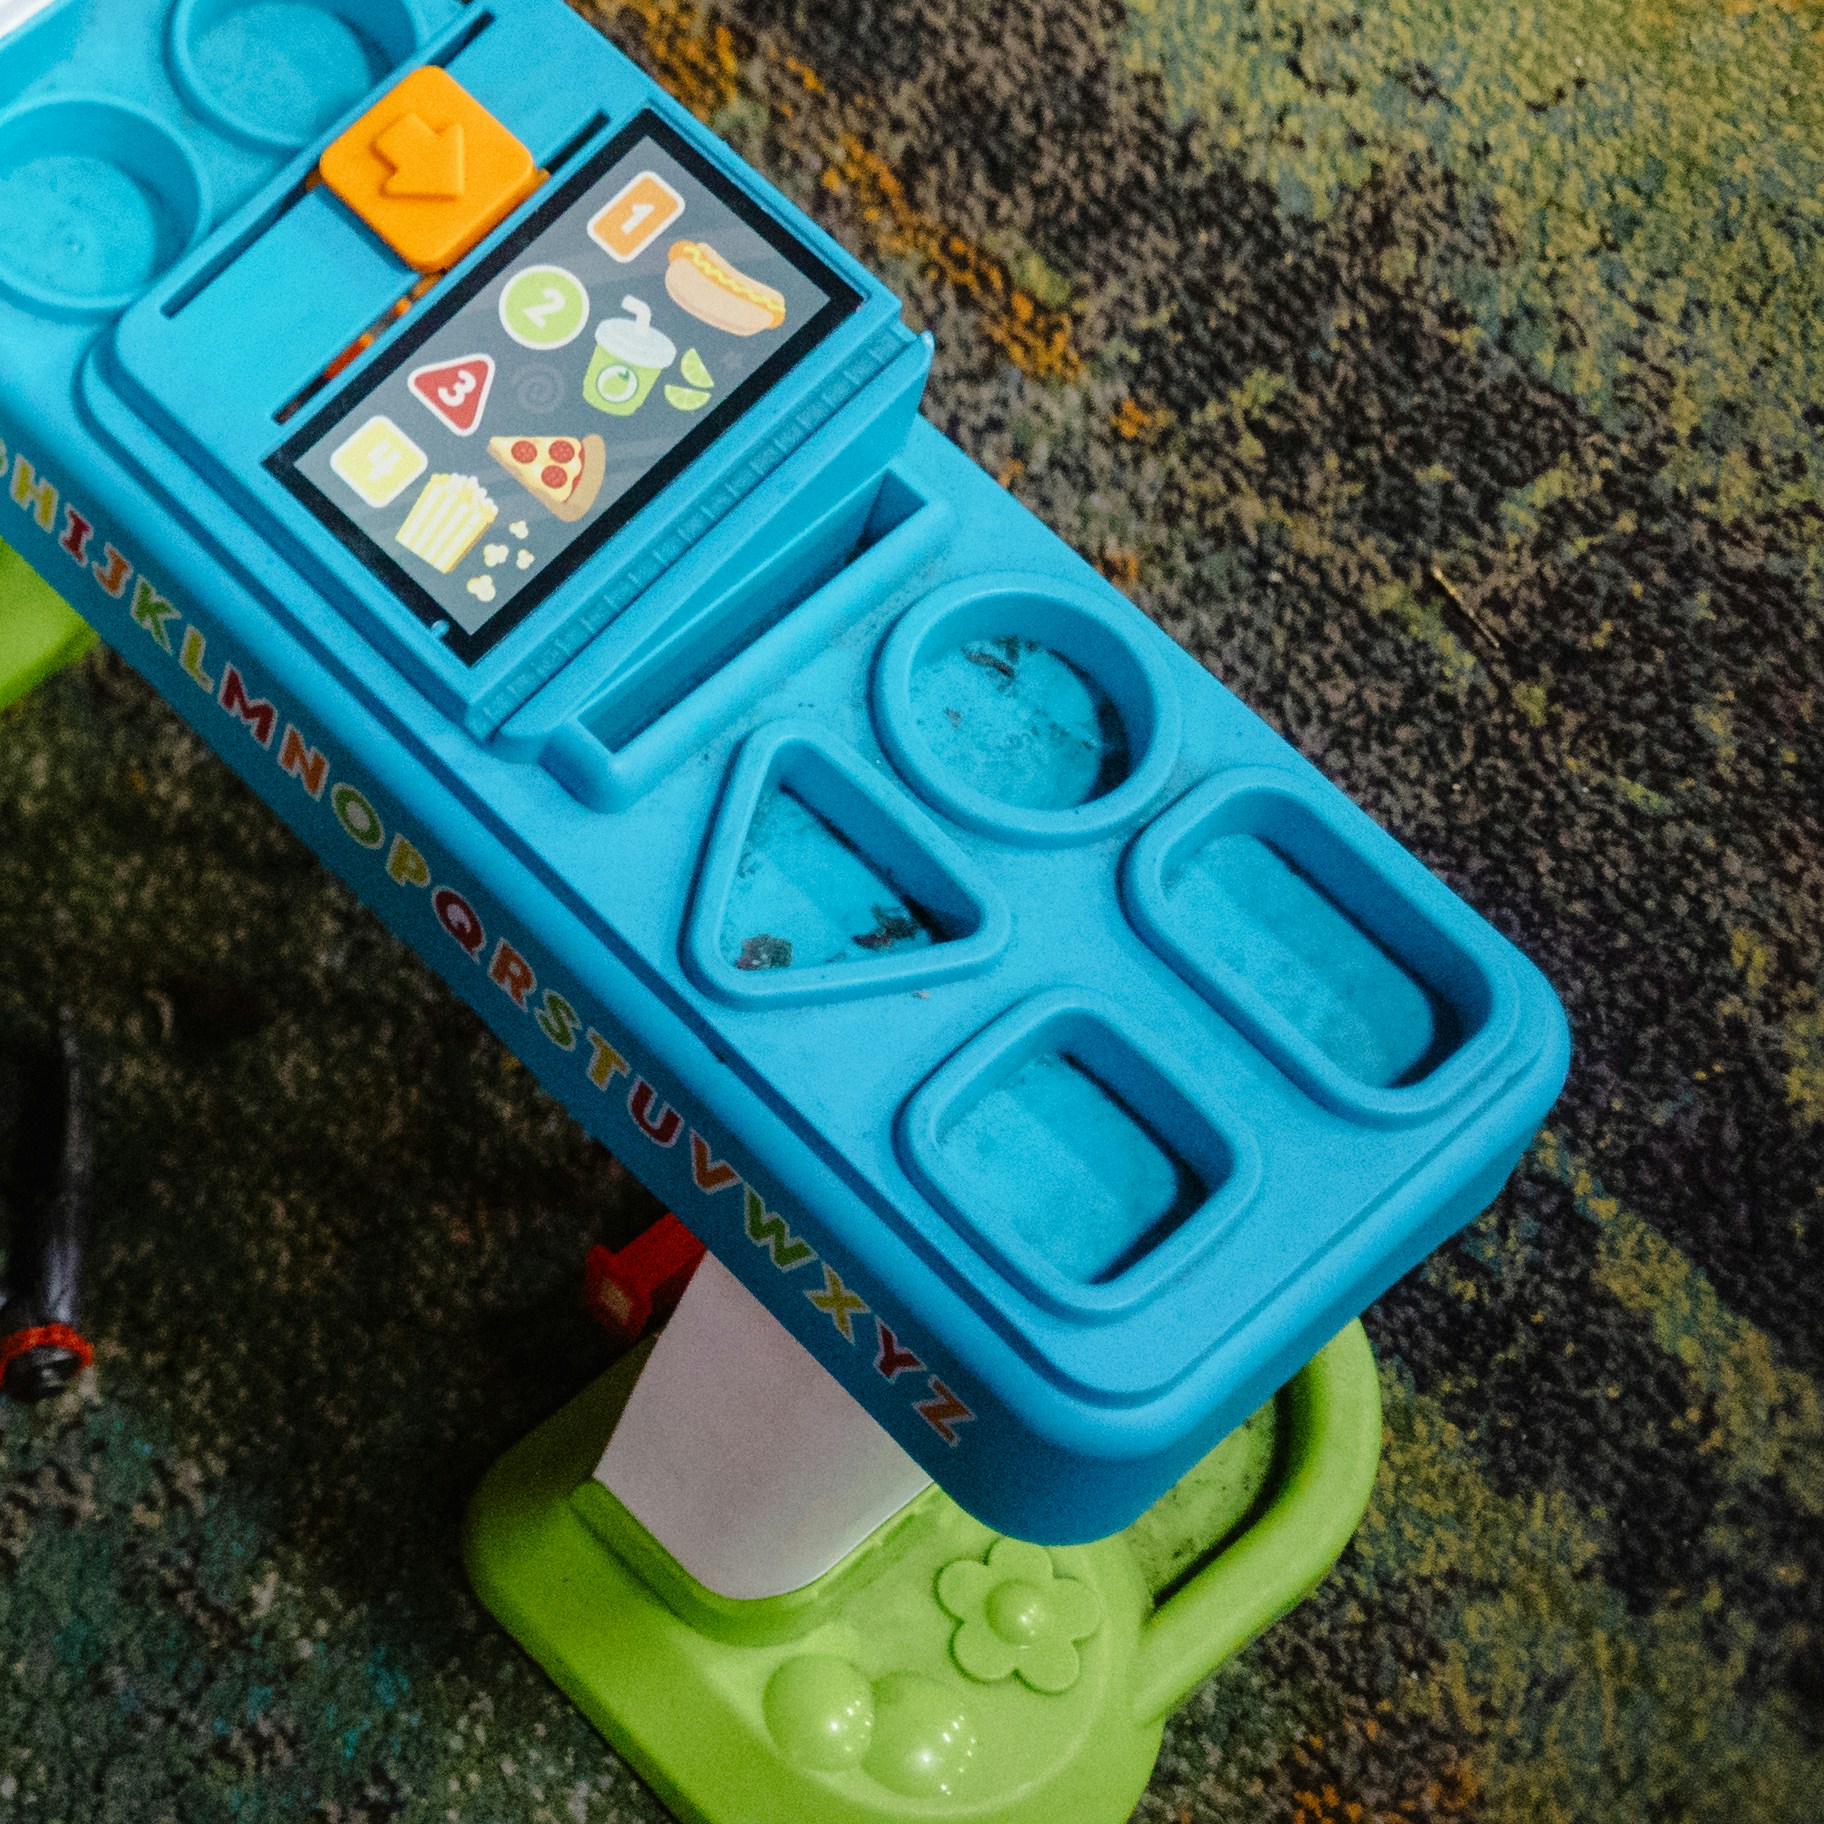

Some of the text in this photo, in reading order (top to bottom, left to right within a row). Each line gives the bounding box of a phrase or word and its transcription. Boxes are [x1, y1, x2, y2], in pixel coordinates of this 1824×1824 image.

[618, 201, 656, 235] 1
[521, 286, 568, 329] 2
[436, 369, 478, 408] 3
[365, 438, 402, 483] 4
